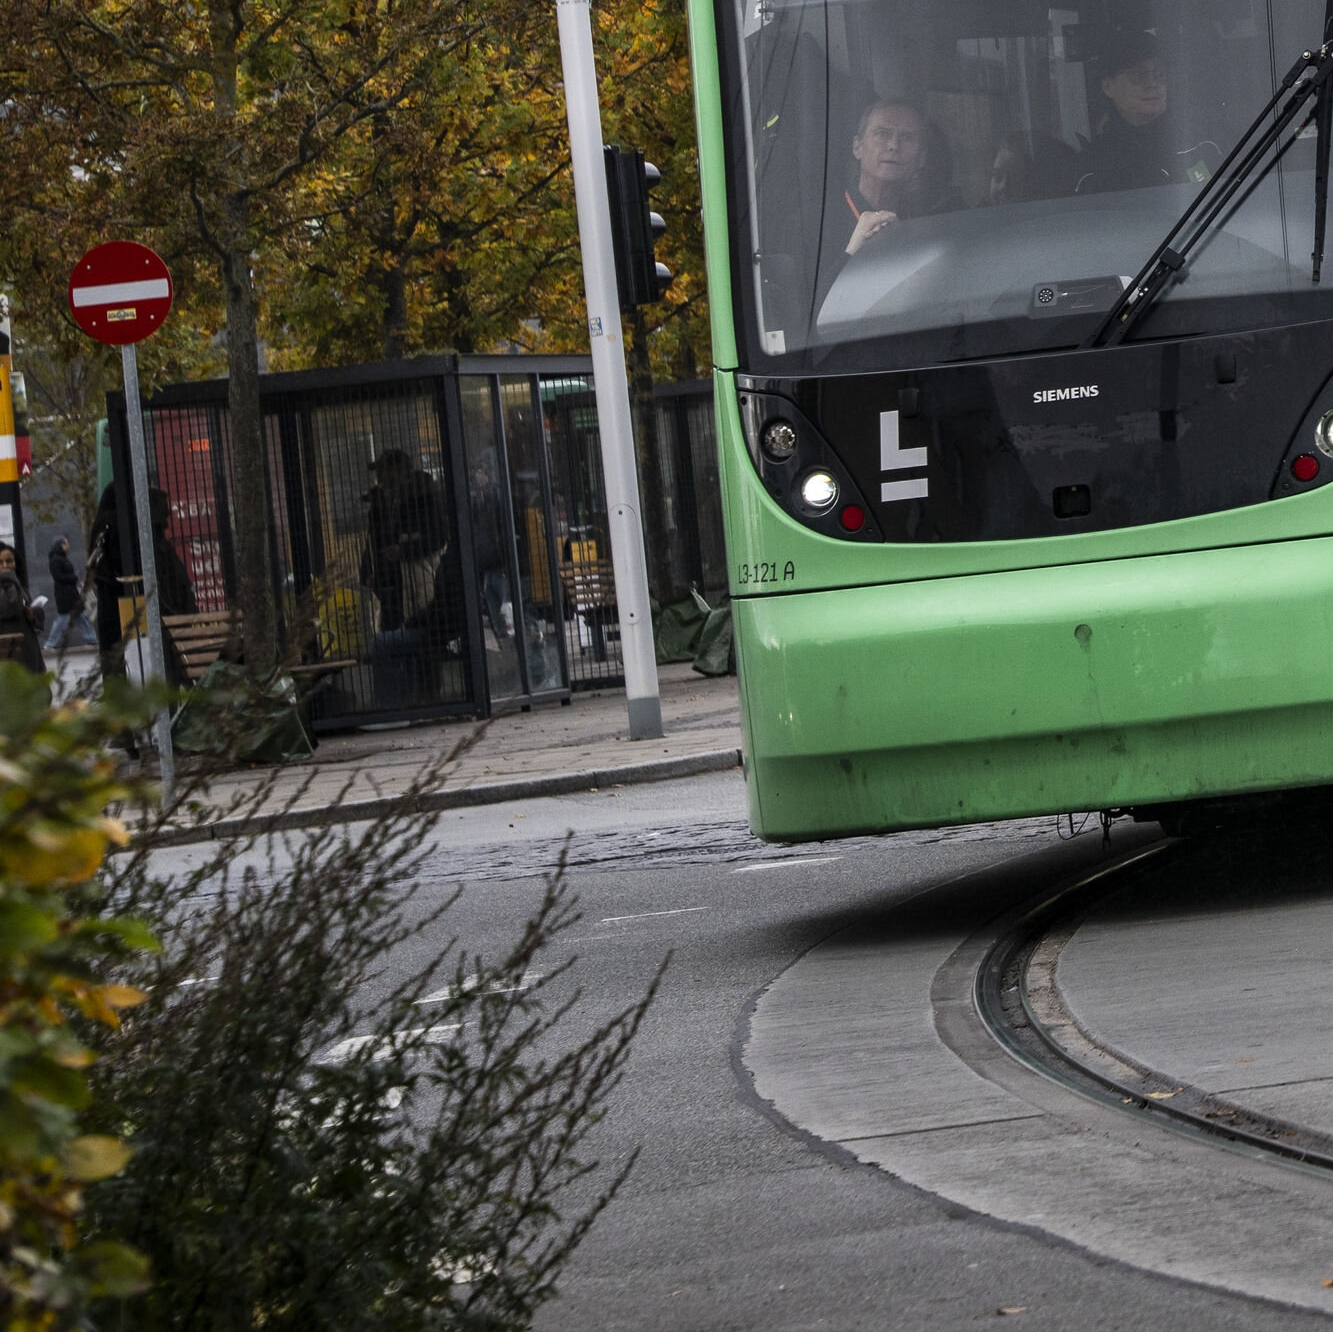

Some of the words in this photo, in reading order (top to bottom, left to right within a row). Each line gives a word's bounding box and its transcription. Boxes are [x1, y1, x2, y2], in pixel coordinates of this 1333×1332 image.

[1033, 385, 1099, 403] SIEMENS
[738, 562, 778, 584] L3-121
[783, 560, 795, 581] A
